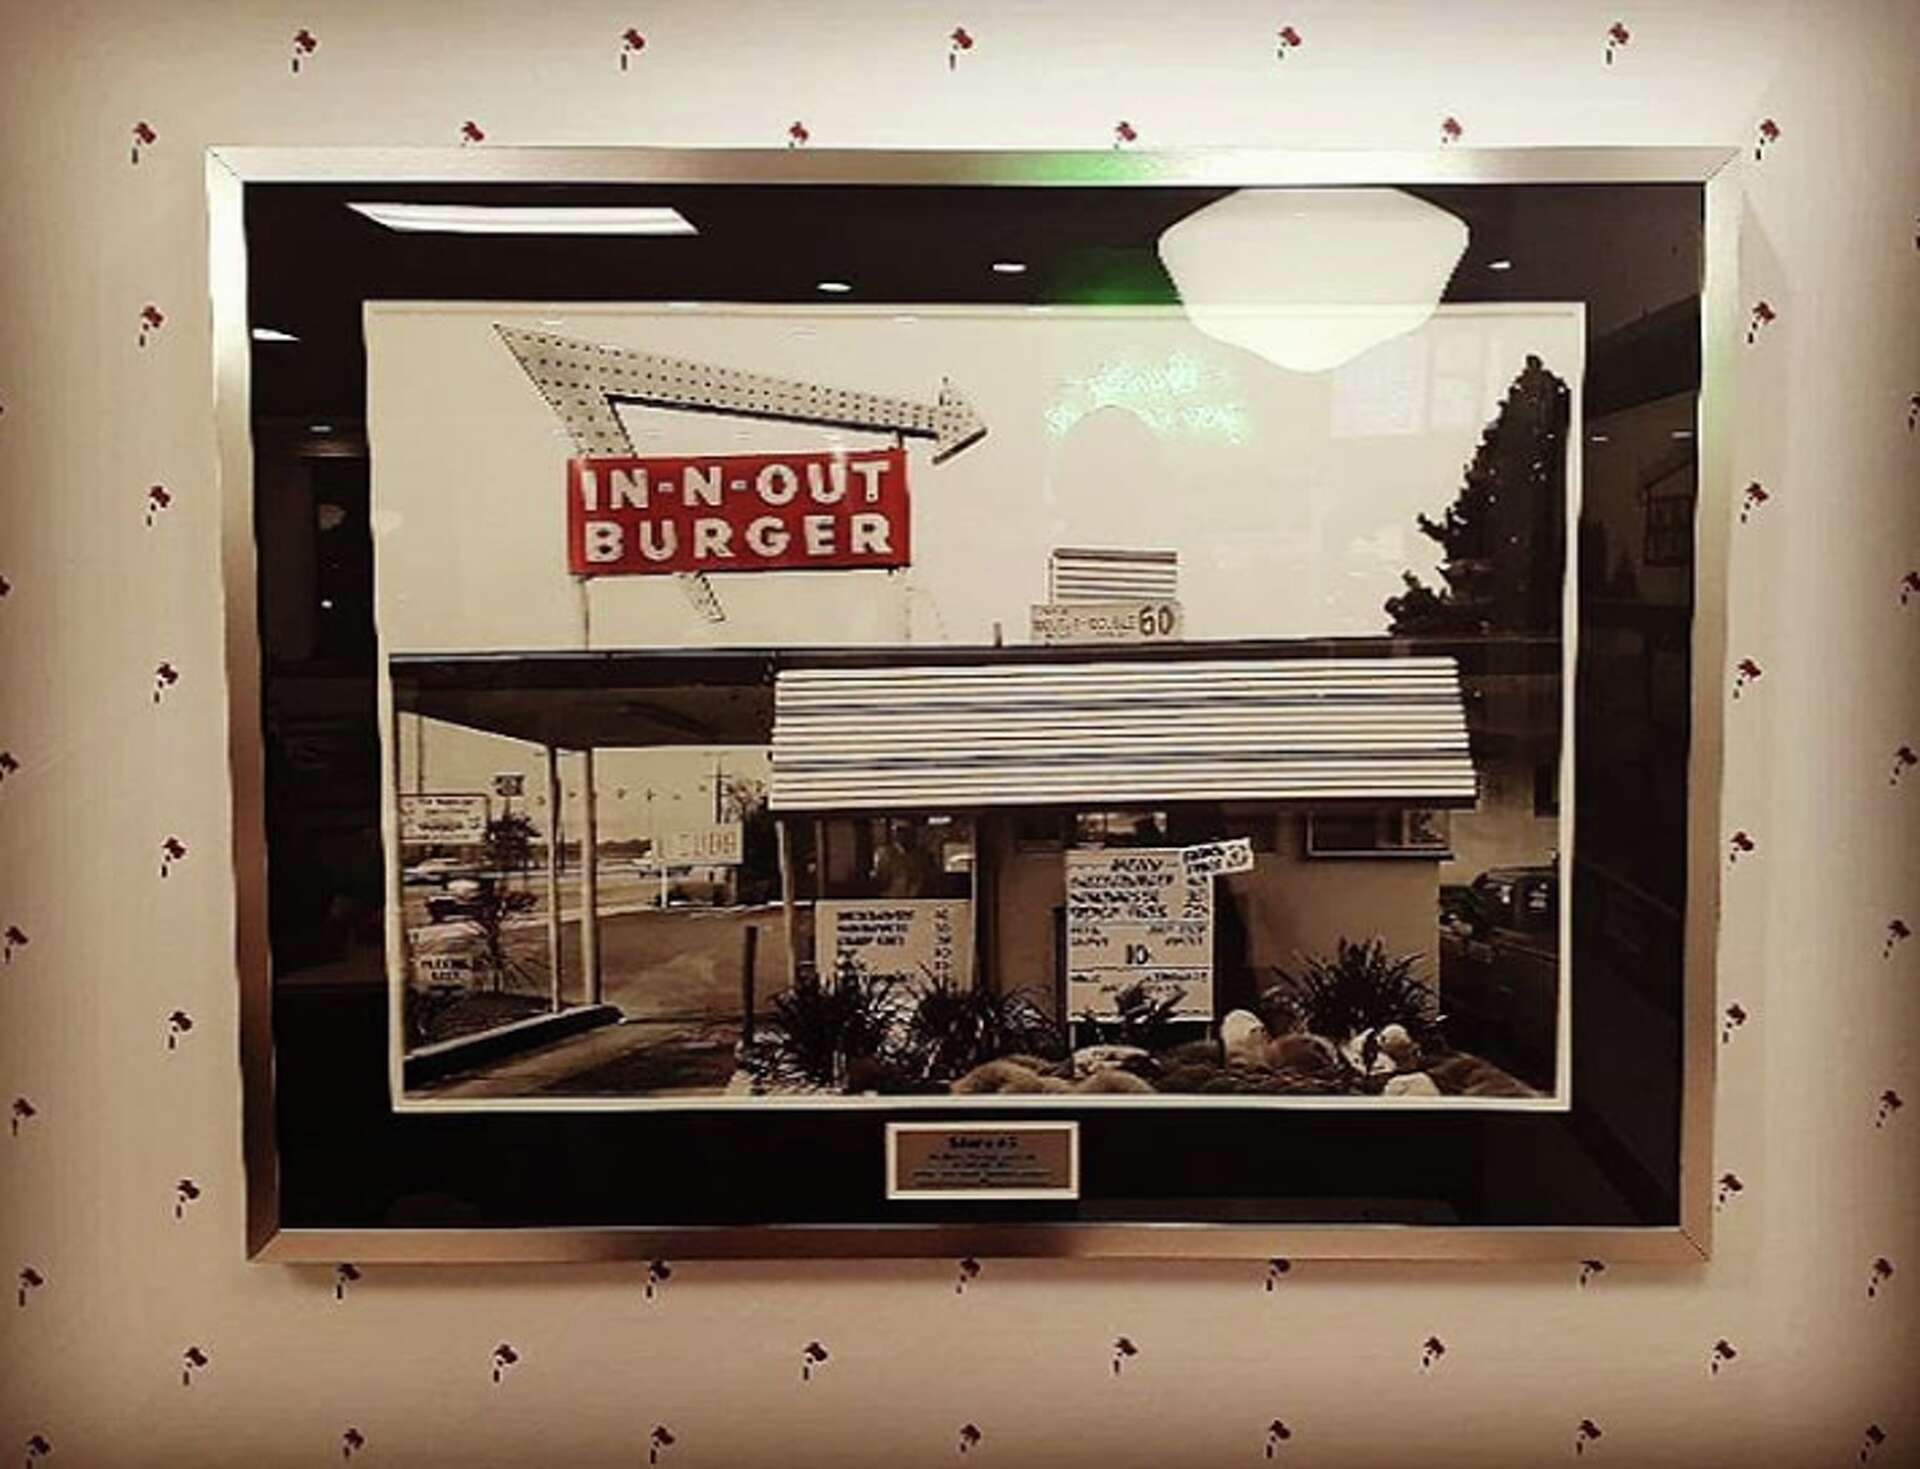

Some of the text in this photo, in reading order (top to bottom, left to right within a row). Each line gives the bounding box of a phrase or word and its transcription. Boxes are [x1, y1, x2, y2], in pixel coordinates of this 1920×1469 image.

[581, 461, 891, 511] IN-N-OUT
[584, 513, 893, 562] BURGER
[1139, 605, 1175, 636] 60
